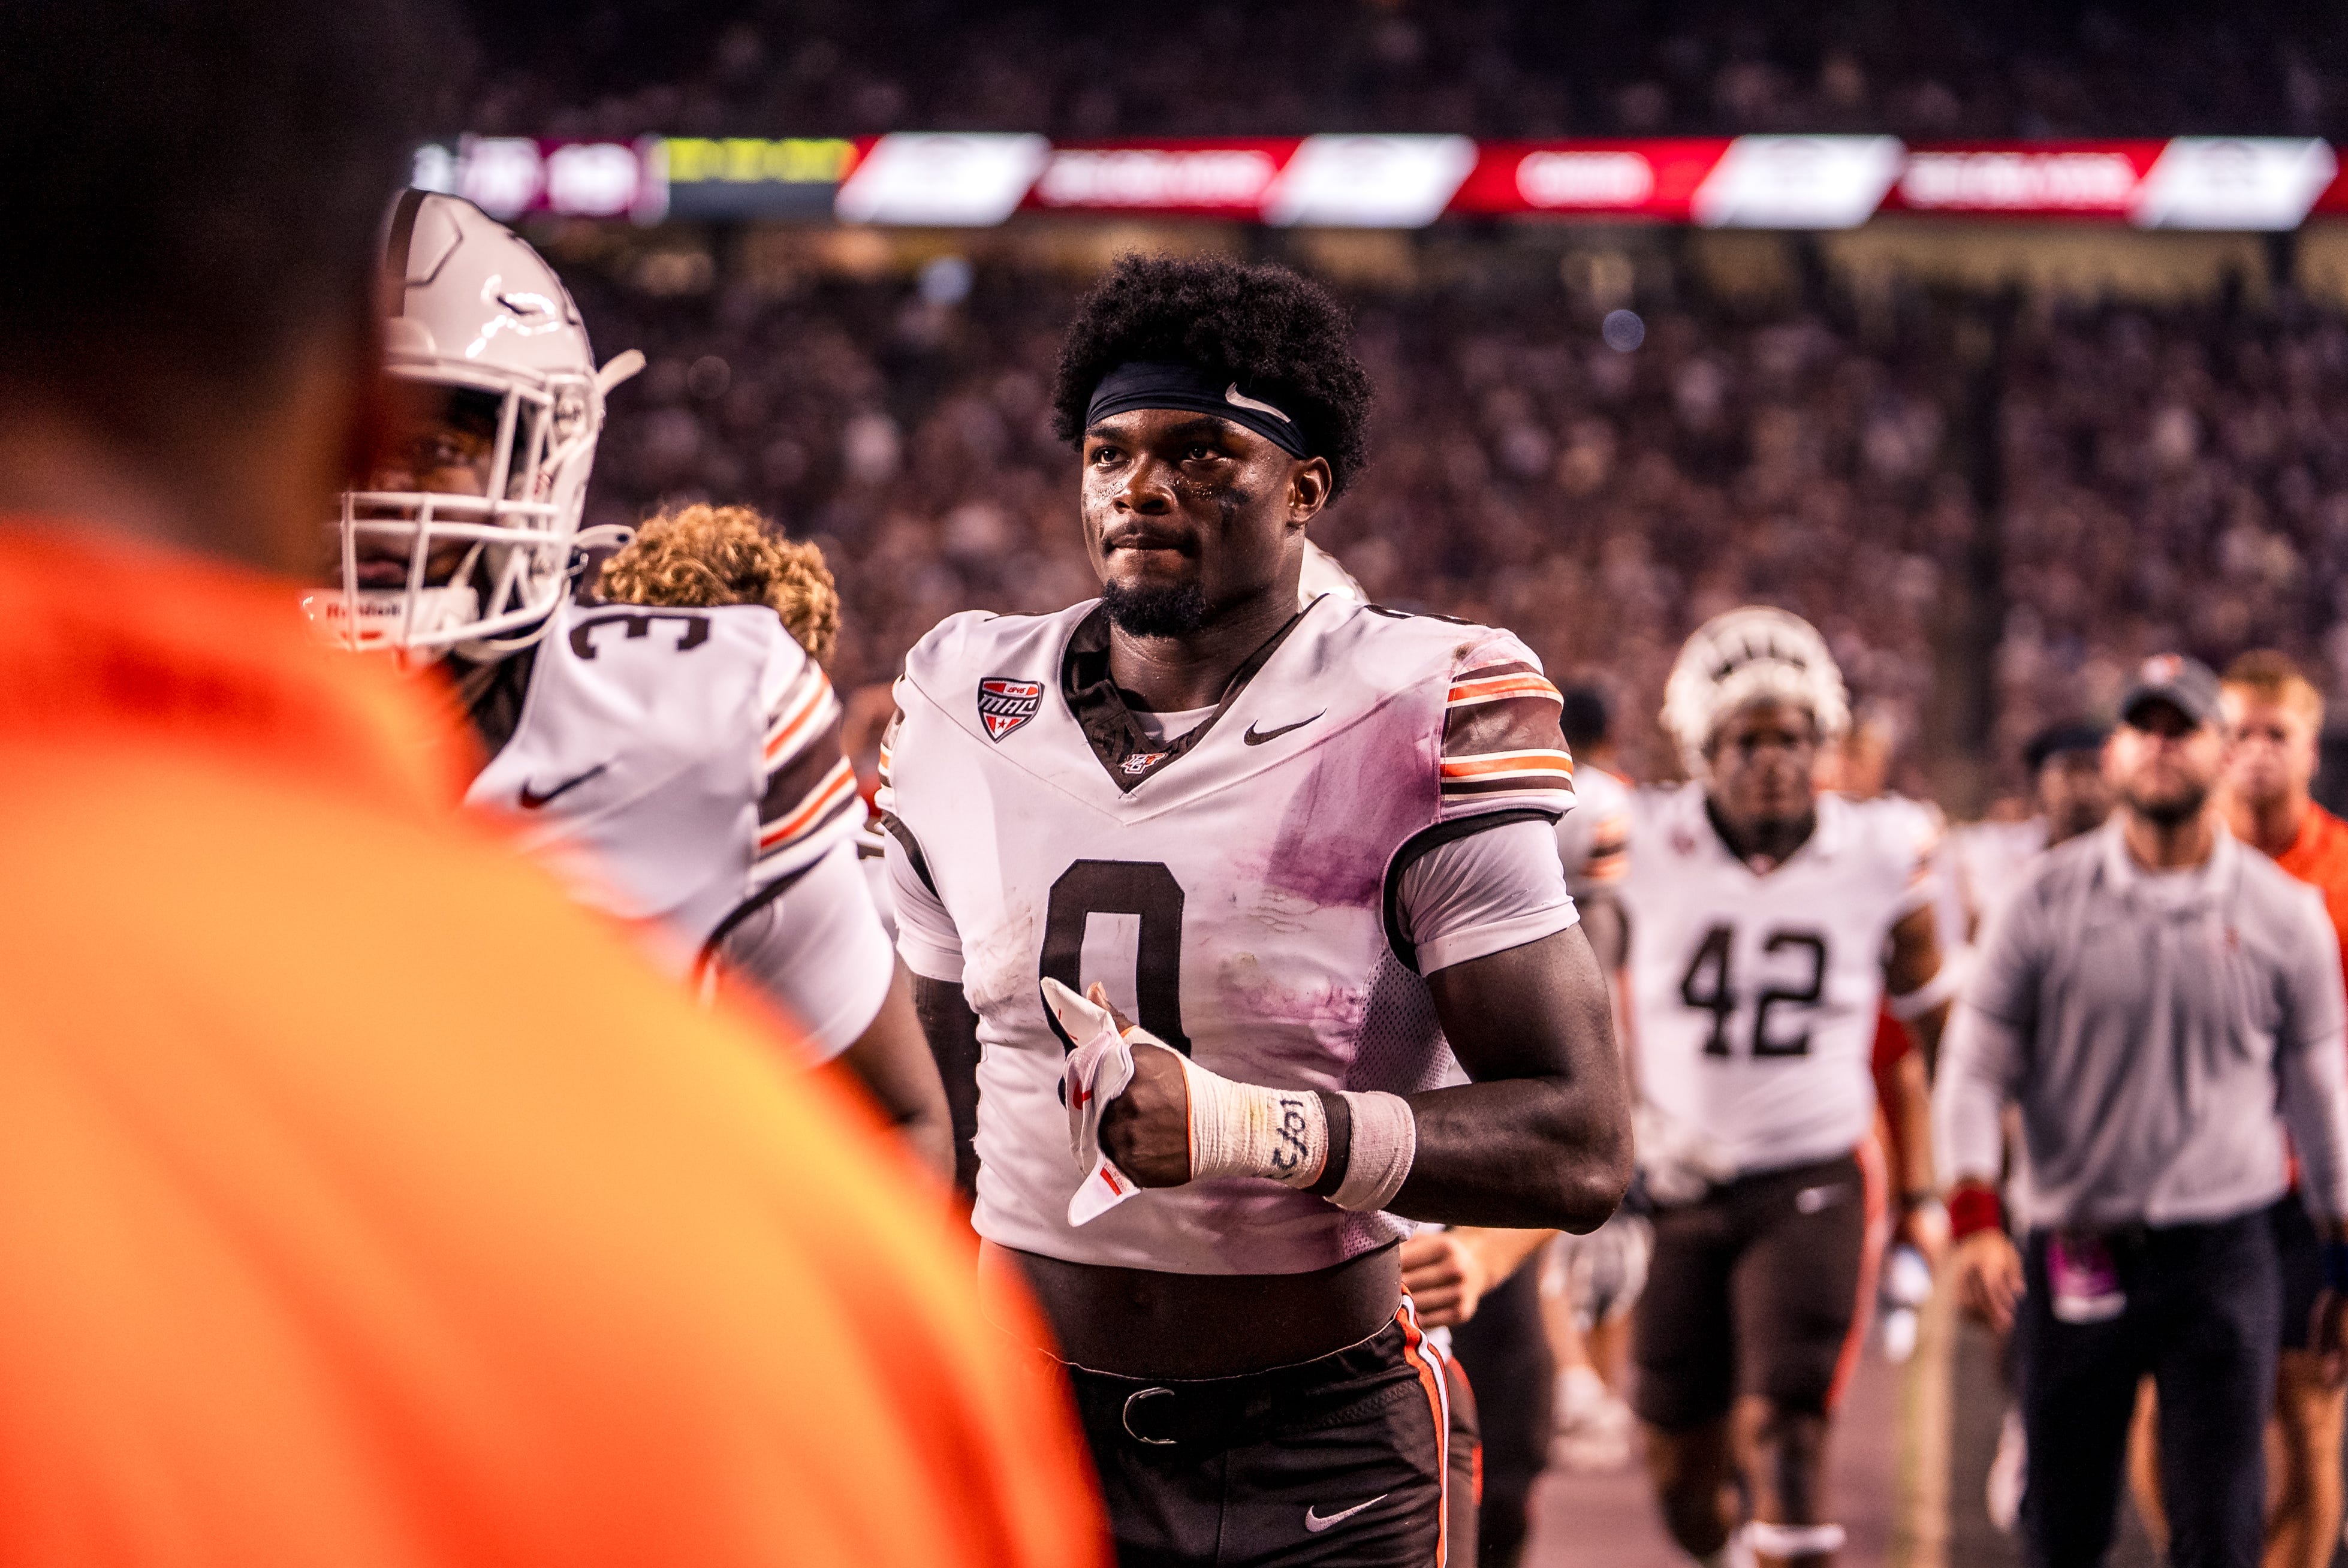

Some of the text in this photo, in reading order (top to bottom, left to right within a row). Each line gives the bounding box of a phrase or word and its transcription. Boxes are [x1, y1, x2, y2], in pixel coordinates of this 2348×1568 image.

[569, 612, 710, 660] 3
[978, 693, 1037, 716] MAC
[1039, 858, 1192, 1109] 0
[1681, 922, 1827, 1057] 42
